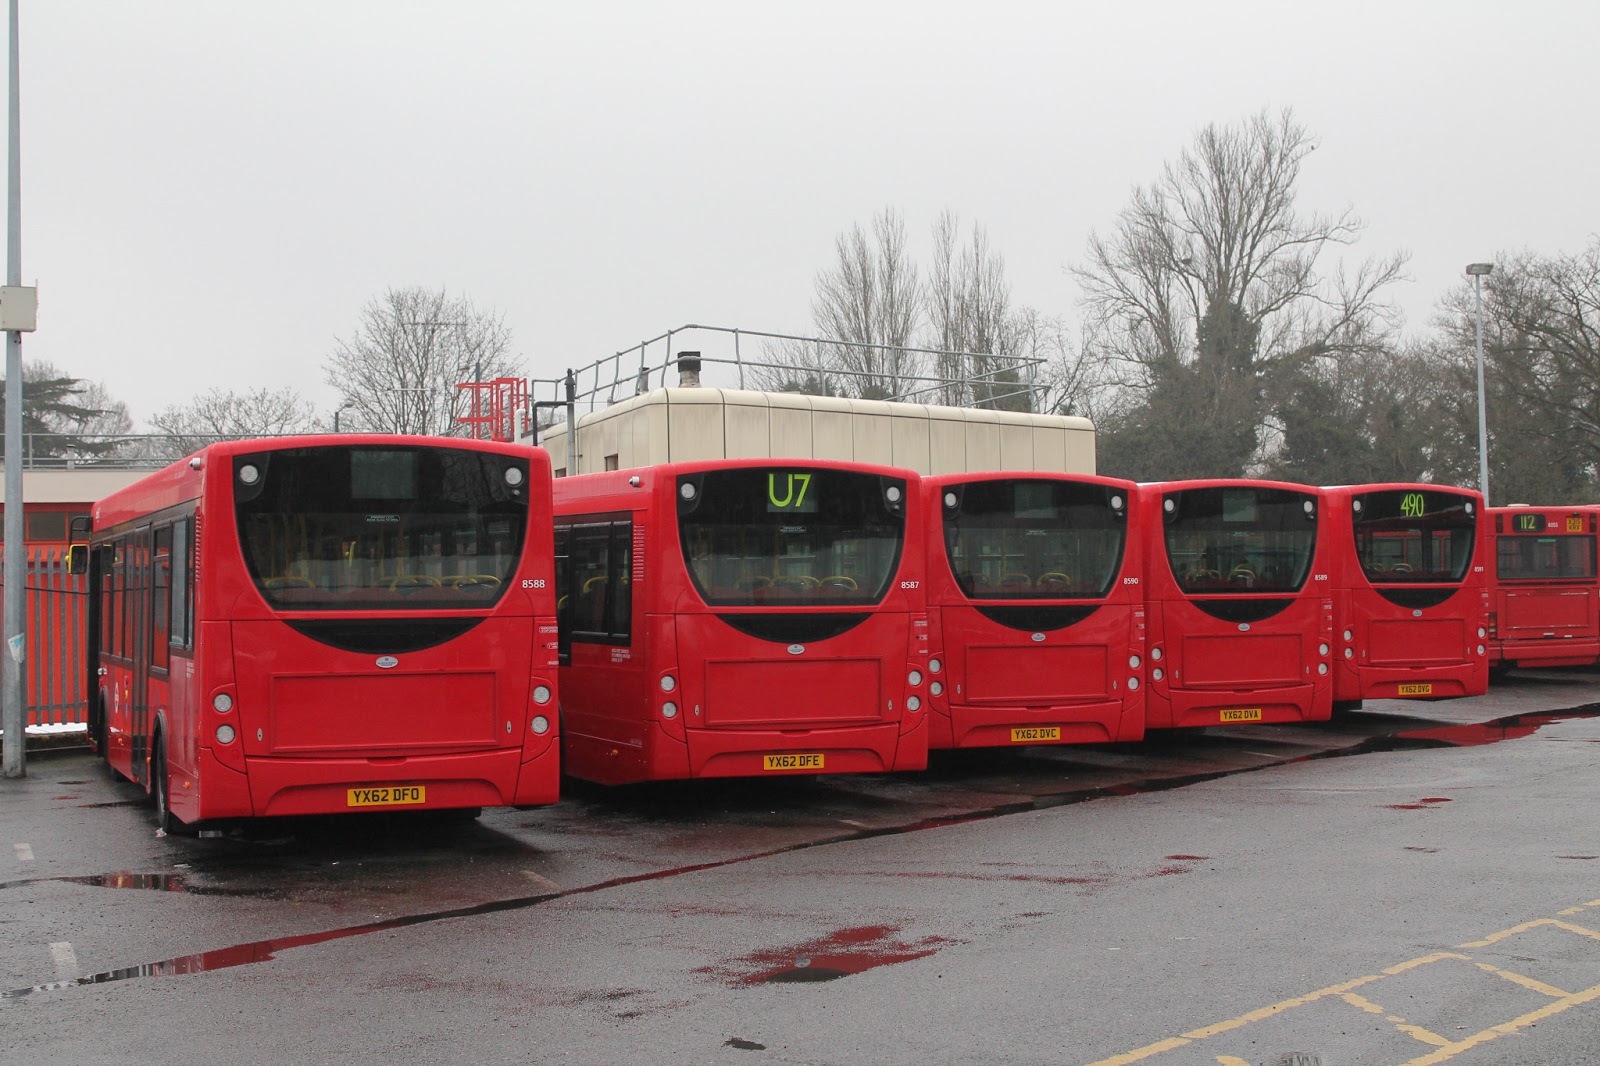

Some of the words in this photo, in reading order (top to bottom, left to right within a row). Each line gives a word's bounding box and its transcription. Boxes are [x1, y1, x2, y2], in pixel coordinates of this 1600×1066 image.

[769, 474, 811, 507] U7
[1401, 494, 1424, 517] 490
[1521, 515, 1535, 529] 112
[522, 579, 545, 589] 8588
[901, 581, 919, 589] 8587
[1123, 577, 1139, 585] 8590
[1401, 685, 1416, 693] YX62
[1223, 710, 1243, 719] YX62
[1244, 710, 1258, 718] DVA
[1015, 730, 1038, 739] YX62
[1040, 729, 1057, 738] DVC
[768, 756, 796, 767] YX62
[799, 755, 820, 767] DFE
[353, 789, 389, 803] YX62
[393, 788, 419, 801] DFO
